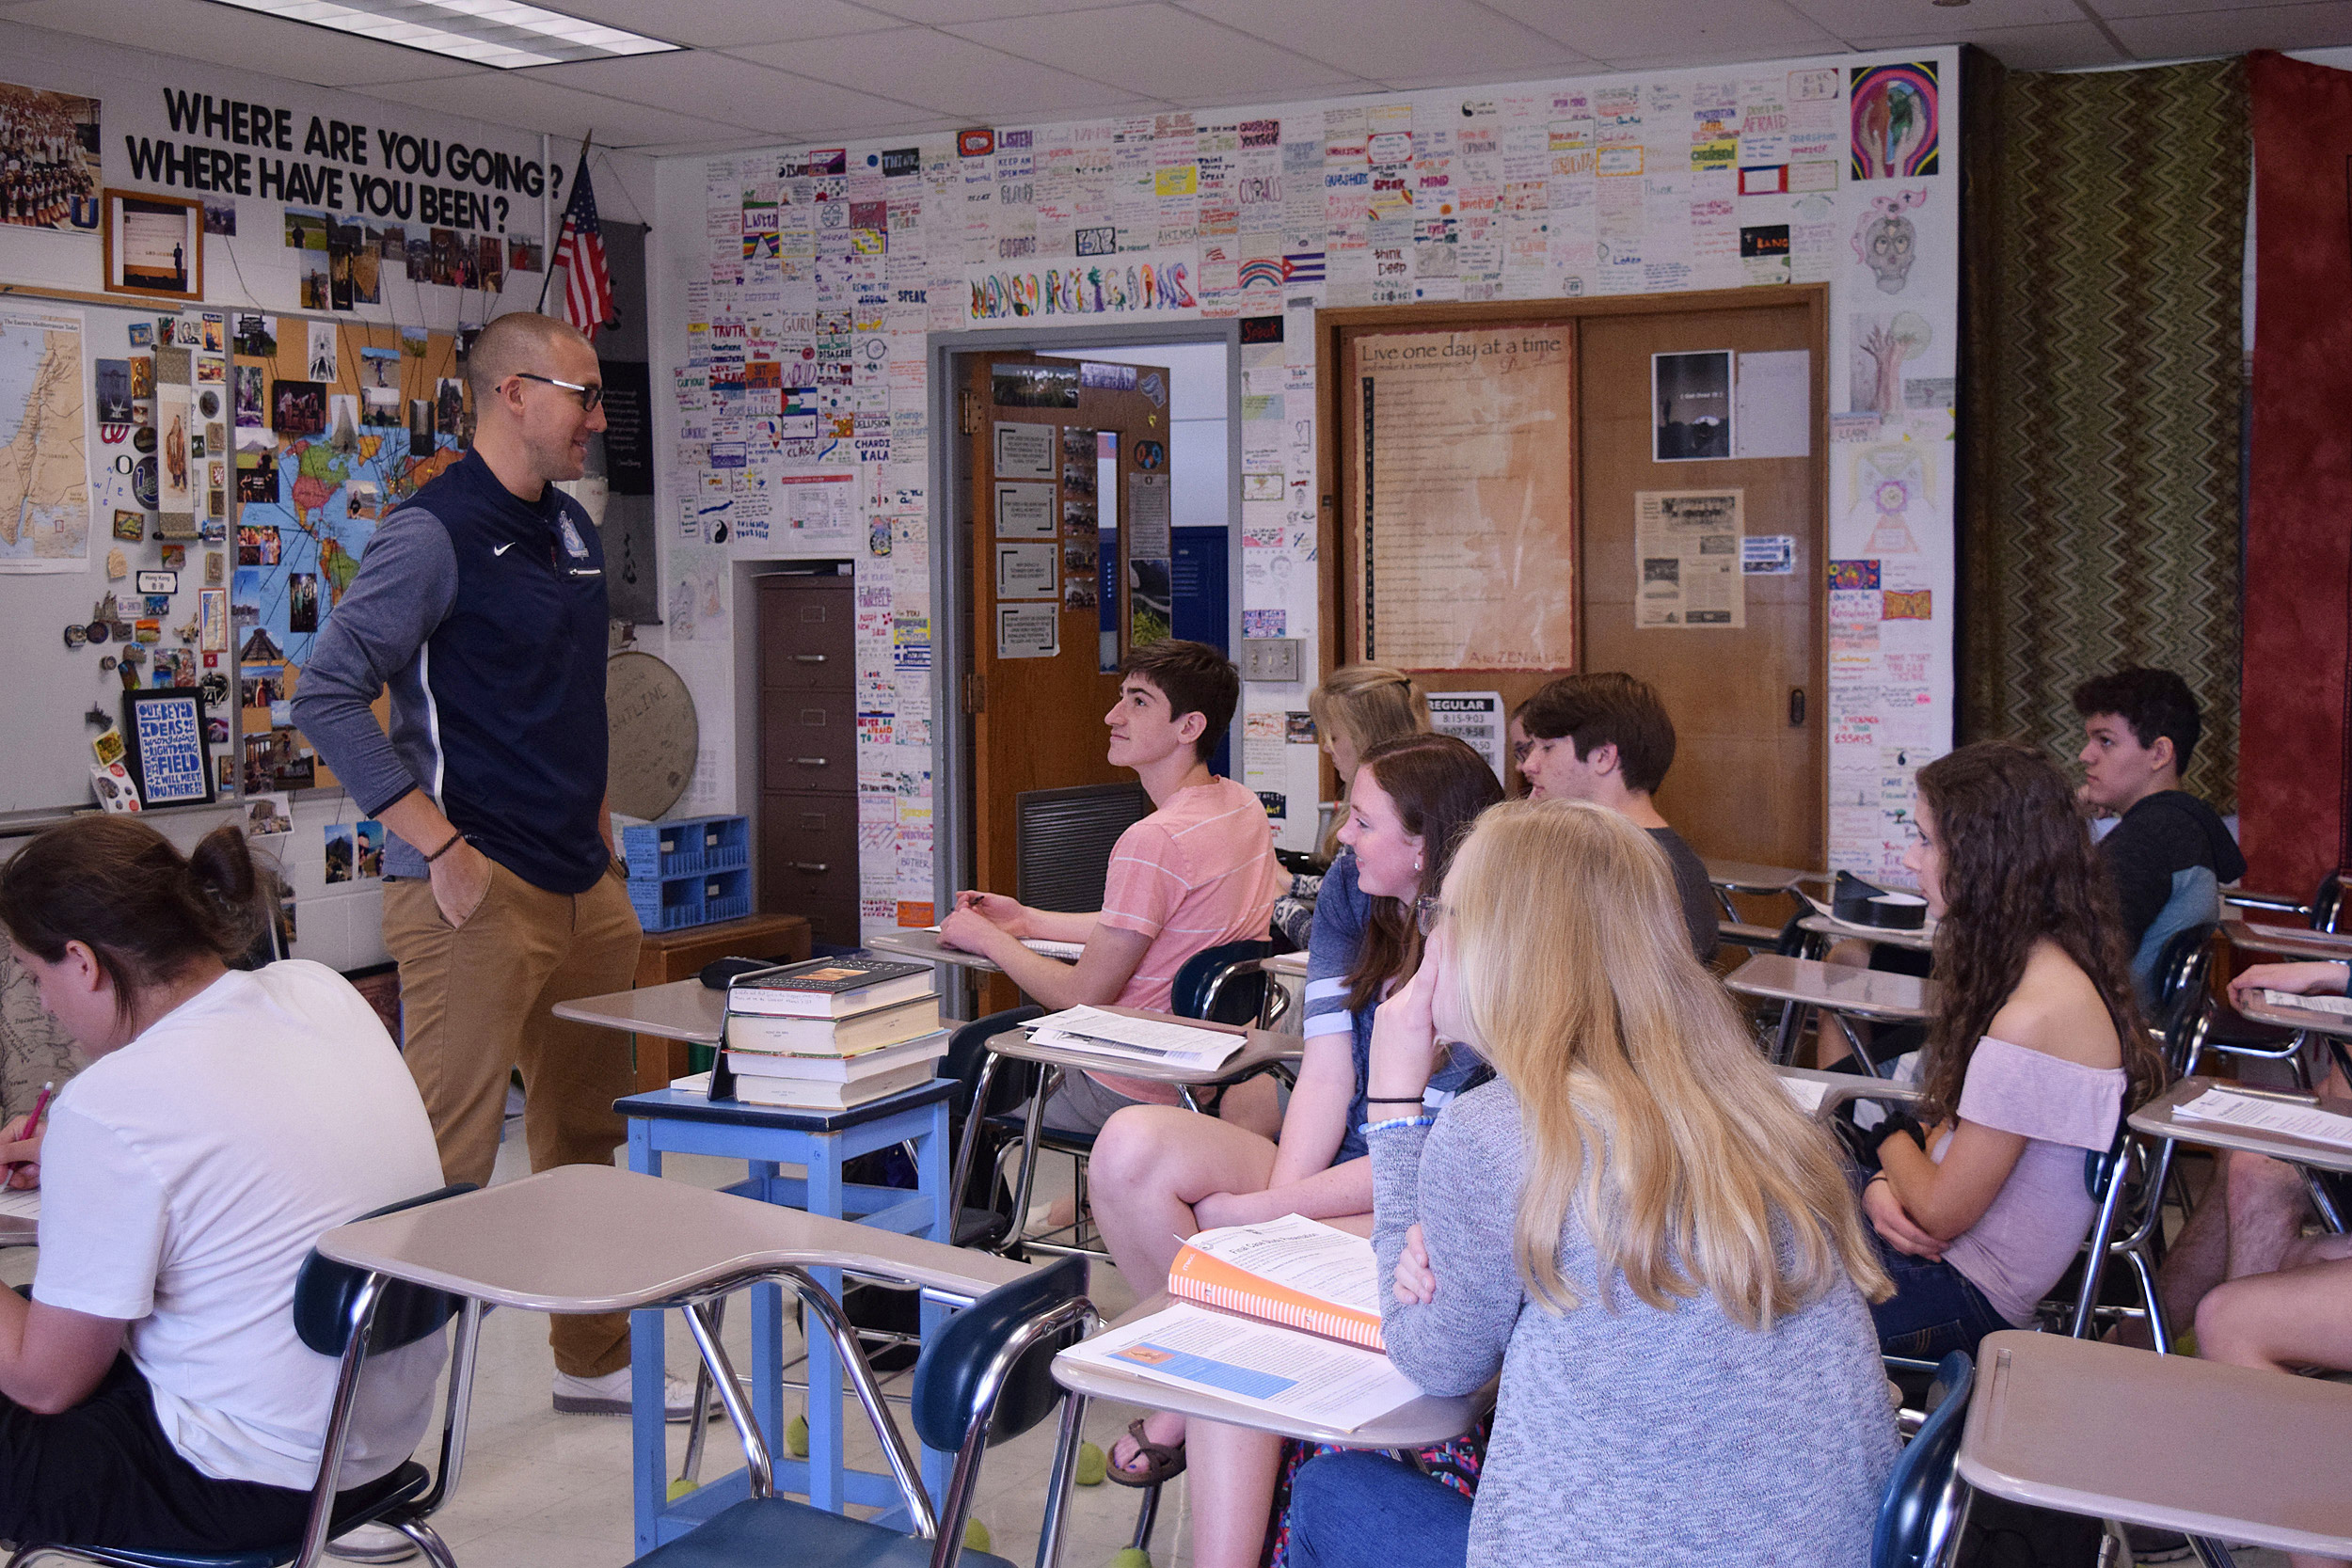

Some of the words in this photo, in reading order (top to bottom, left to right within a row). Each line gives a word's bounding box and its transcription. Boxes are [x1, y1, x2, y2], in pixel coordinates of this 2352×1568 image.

[1742, 115, 1788, 134] AFRAID
[163, 87, 293, 151] WHERE
[304, 116, 368, 166] ARE
[378, 129, 440, 178] YOU
[997, 158, 1019, 166] KEEP
[125, 135, 251, 196] WHERE
[259, 157, 343, 209] HAVE
[349, 172, 413, 220] YOU
[420, 185, 509, 233] BEEN?
[1420, 175, 1450, 187] MIND
[1372, 248, 1404, 261] think
[1377, 262, 1407, 277] Deep
[898, 290, 928, 304] SPEAK
[712, 324, 746, 339] TRUTH
[782, 318, 816, 333] GURU
[818, 349, 852, 358] DISAGREE
[1361, 342, 1398, 361] Live
[1403, 345, 1437, 359] one
[1442, 334, 1478, 365] day
[1482, 338, 1502, 356] at
[1505, 341, 1518, 355] a
[1522, 334, 1562, 354] time
[854, 438, 891, 450] CHARDI
[787, 445, 816, 458] CLASS
[861, 450, 890, 463] KALA
[1428, 700, 1486, 711] REGULAR
[140, 720, 183, 737] IDEAS
[857, 719, 879, 727] NEVER
[873, 734, 891, 744] ASK
[158, 754, 199, 775] FIELD
[162, 774, 181, 784] WILL
[181, 772, 200, 783] MEET
[149, 784, 167, 799] YOU
[167, 783, 195, 796] THERE
